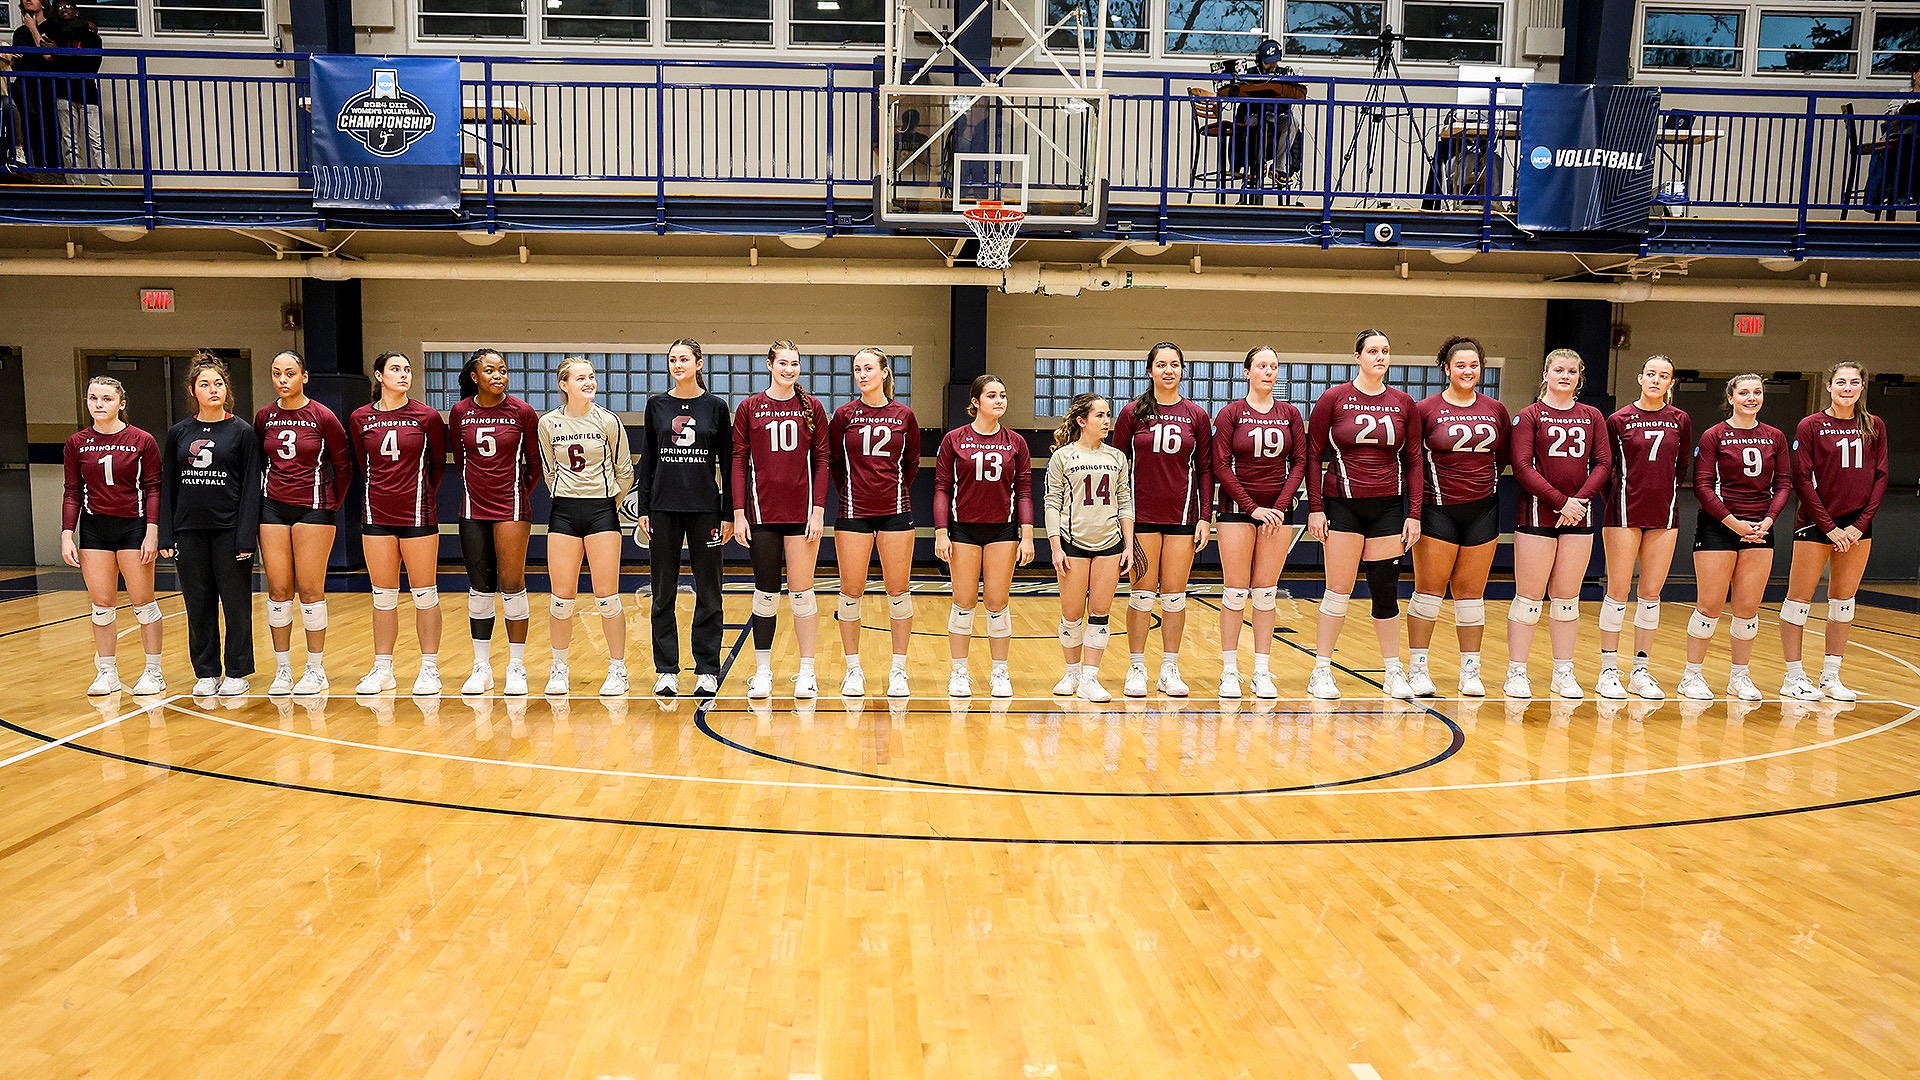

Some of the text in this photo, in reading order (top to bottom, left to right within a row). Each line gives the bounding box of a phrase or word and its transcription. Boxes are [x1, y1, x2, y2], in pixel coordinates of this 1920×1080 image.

[351, 107, 421, 116] WOMEN'S VOLLEYBALL
[340, 115, 432, 129] CHAMPIONSHIP
[1532, 148, 1643, 170] NCAA VOLLEYBALL
[146, 291, 169, 309] EXIT
[1740, 316, 1761, 334] EXIT
[1343, 403, 1401, 413] SPRINGFIELD
[265, 419, 317, 429] SPRINGFIELD
[362, 420, 418, 432] SPRINGFIELD
[461, 418, 516, 426] SPRINGFIELD
[850, 417, 903, 425] SPRINGFIELD
[1147, 414, 1191, 424] RINGFIELD
[1238, 417, 1290, 426] SPRINGFIELD
[1436, 415, 1497, 423] SPRINGFIELD
[1539, 416, 1591, 425] SPRINGFIELD
[1625, 420, 1679, 429] SPRINGFIELD
[552, 433, 602, 443] SPRINGFIELD
[671, 415, 697, 447] S
[765, 420, 798, 452] 10
[1150, 423, 1182, 454] 16
[1355, 414, 1396, 446] 21
[1448, 423, 1497, 453] 22
[79, 445, 137, 453] SPRINGFIELD
[276, 429, 297, 460] 3
[380, 429, 401, 462] 4
[475, 426, 497, 457] 5
[858, 424, 892, 457] 12
[960, 443, 1013, 451] SPRINGFIELD
[1247, 426, 1284, 458] 19
[1547, 426, 1587, 458] 23
[1644, 430, 1665, 462] 7
[1721, 438, 1774, 446] SPRINGFIELD
[187, 439, 216, 468] S
[567, 443, 586, 473] 6
[660, 447, 709, 456] SPRINGFIELD
[660, 456, 706, 464] VOLLEYBALL
[1835, 437, 1863, 468] 11
[98, 454, 115, 486] 1
[970, 451, 1003, 482] 13
[1070, 464, 1118, 473] SPRINGFIELD
[1742, 447, 1763, 477] 9
[1083, 473, 1111, 506] 14
